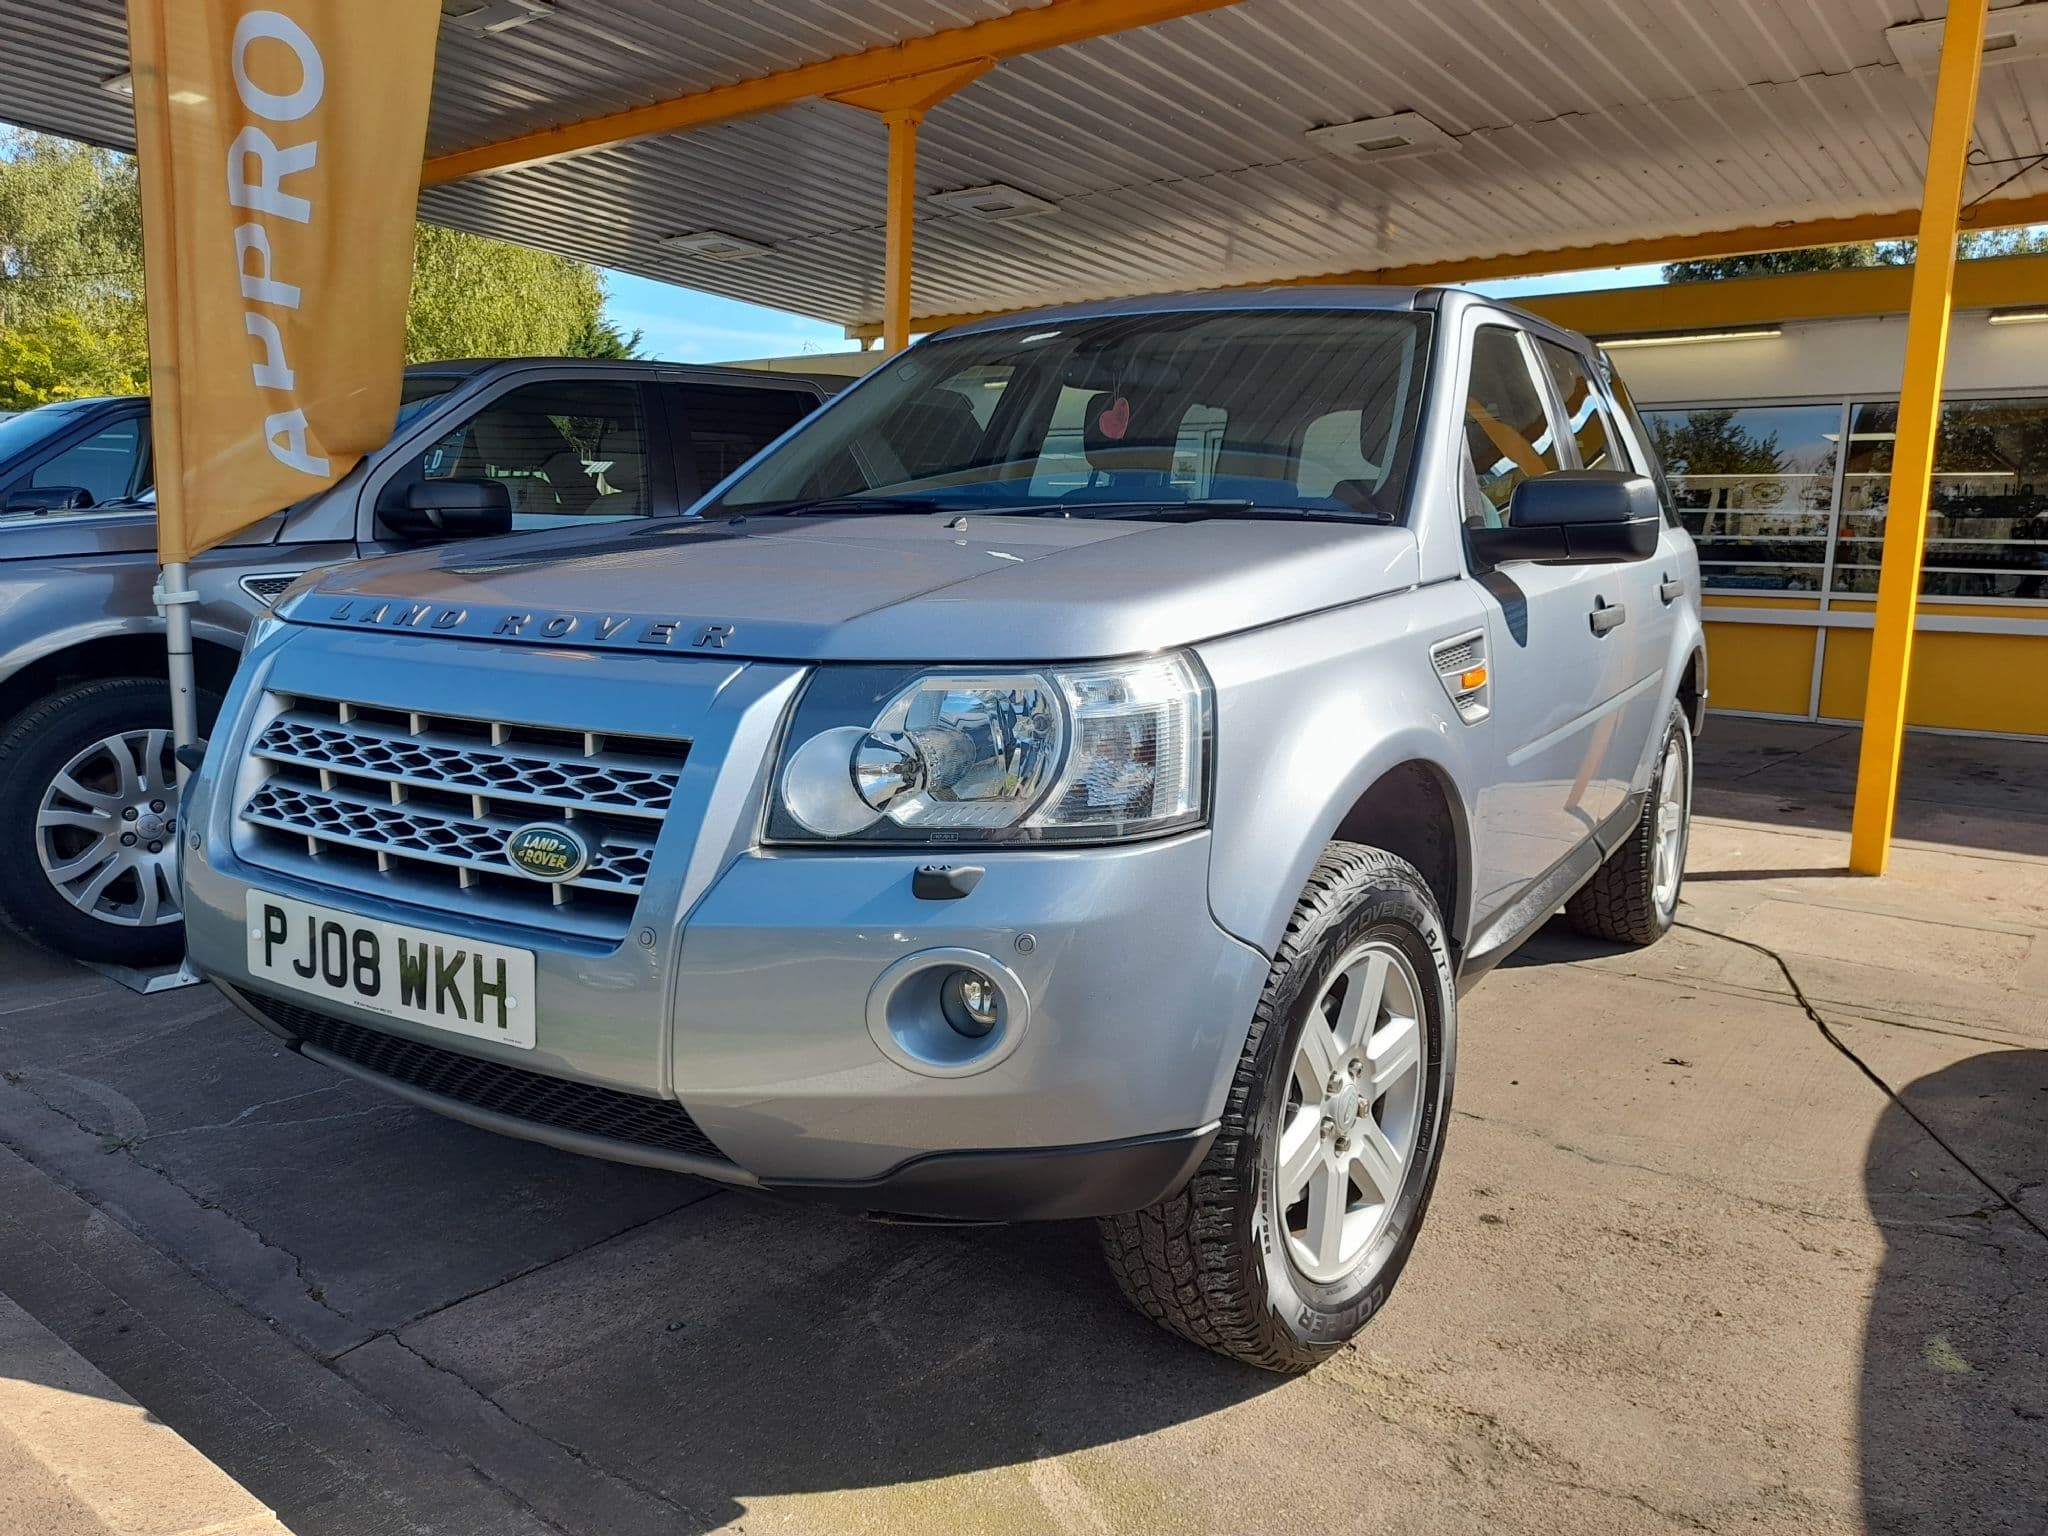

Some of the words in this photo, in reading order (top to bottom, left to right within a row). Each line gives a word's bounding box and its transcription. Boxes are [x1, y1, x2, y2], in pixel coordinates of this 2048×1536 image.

[329, 600, 468, 629] LAND
[493, 613, 736, 649] ROVER
[523, 834, 559, 852] LAND
[523, 849, 568, 869] ROVER
[263, 903, 381, 997] PJ08
[398, 937, 508, 1030] WKH
